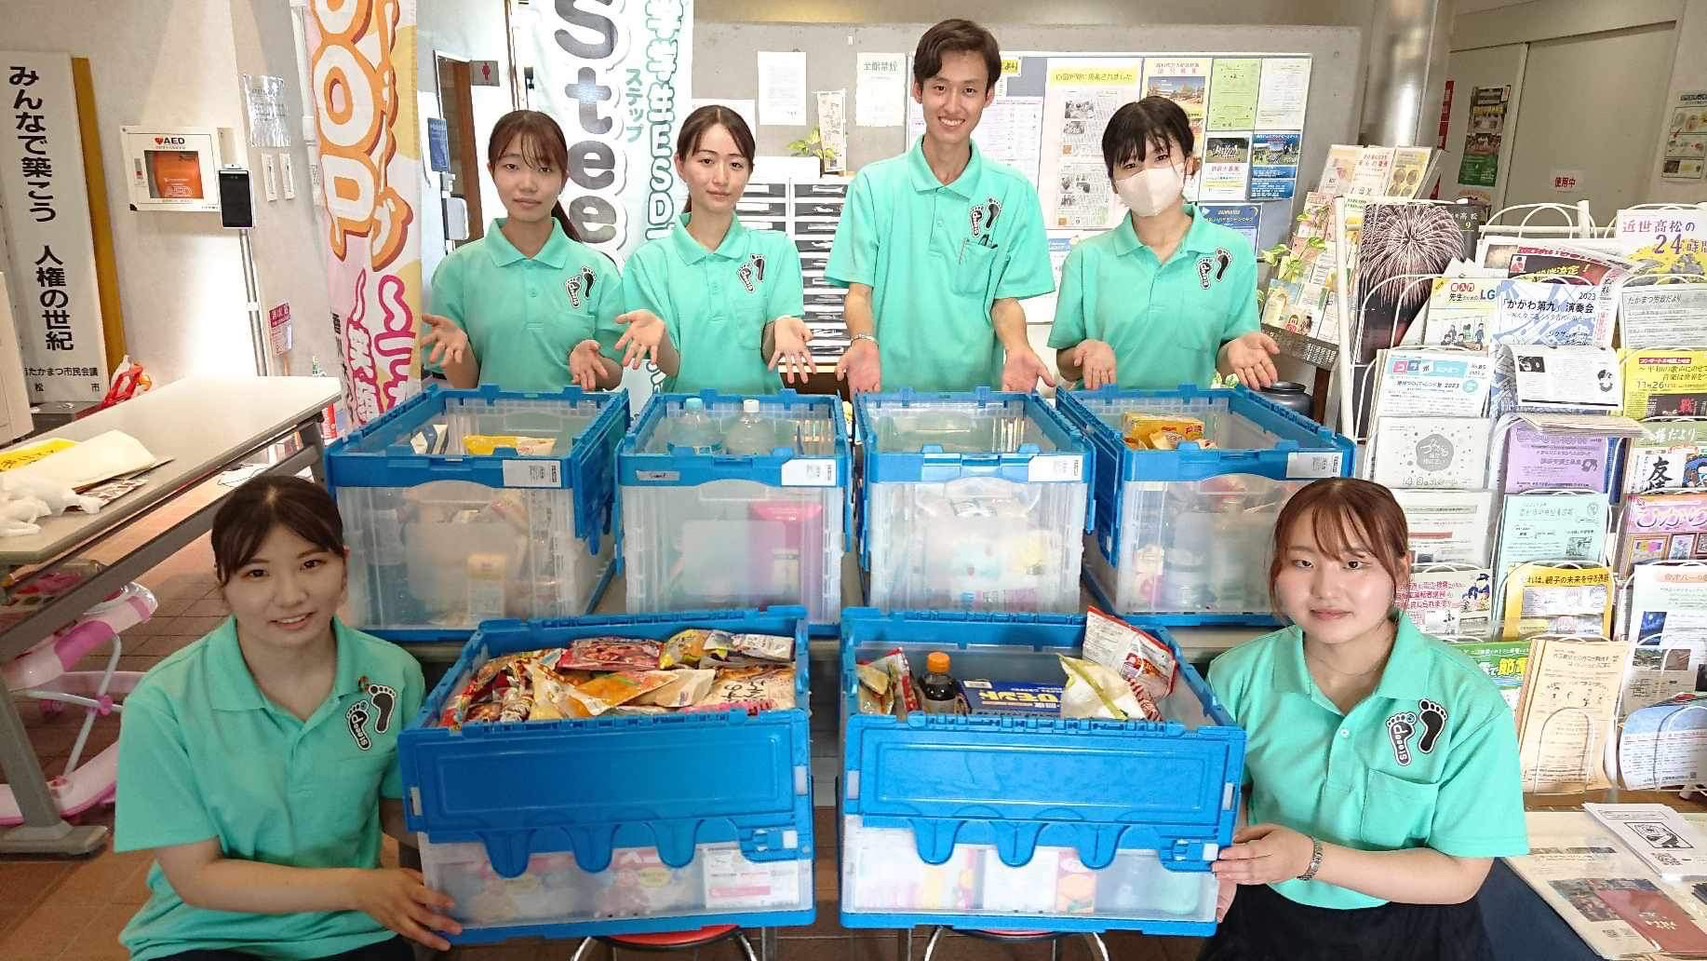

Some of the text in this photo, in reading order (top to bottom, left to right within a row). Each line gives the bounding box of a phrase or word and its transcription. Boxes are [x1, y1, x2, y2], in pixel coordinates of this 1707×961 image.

[625, 68, 644, 143] ステップ
[163, 137, 186, 145] AED
[1554, 176, 1576, 188] 使用中
[8, 65, 74, 352] みんなで築こう 人権の世紀
[1622, 219, 1696, 233] 近世高松の
[1579, 291, 1597, 301] 2023
